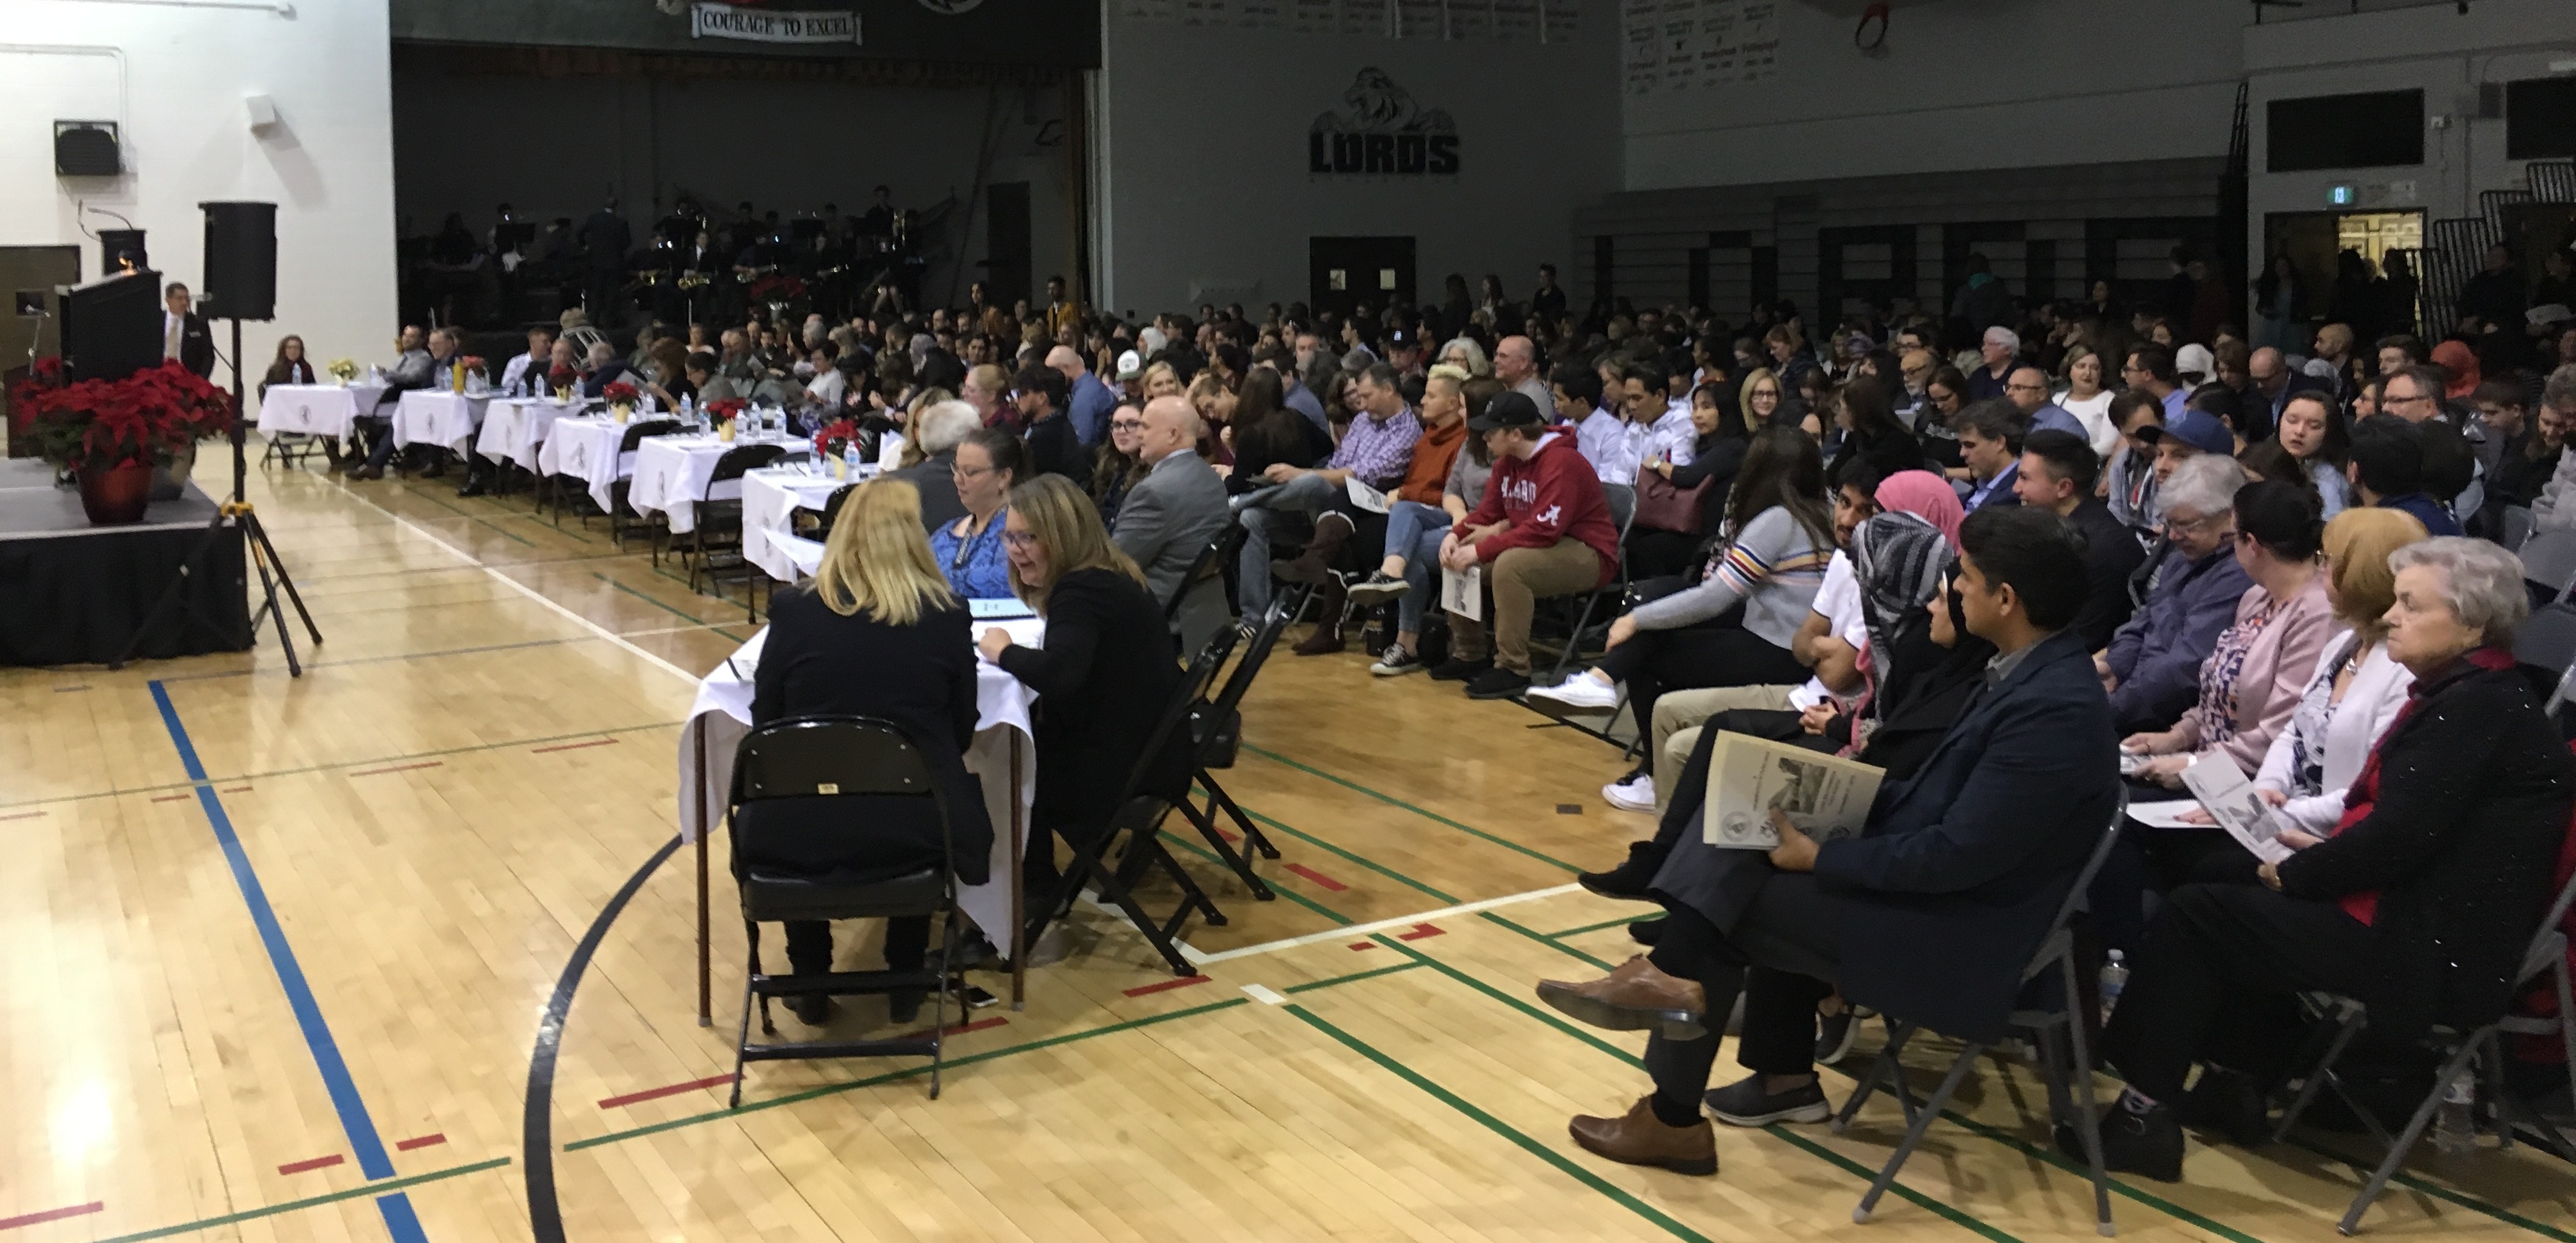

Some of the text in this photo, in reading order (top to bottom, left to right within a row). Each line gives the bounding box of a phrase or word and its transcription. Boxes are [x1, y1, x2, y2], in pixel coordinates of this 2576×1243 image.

[703, 10, 852, 36] COURAGE TO EXCEL
[1310, 132, 1459, 173] LORDS
